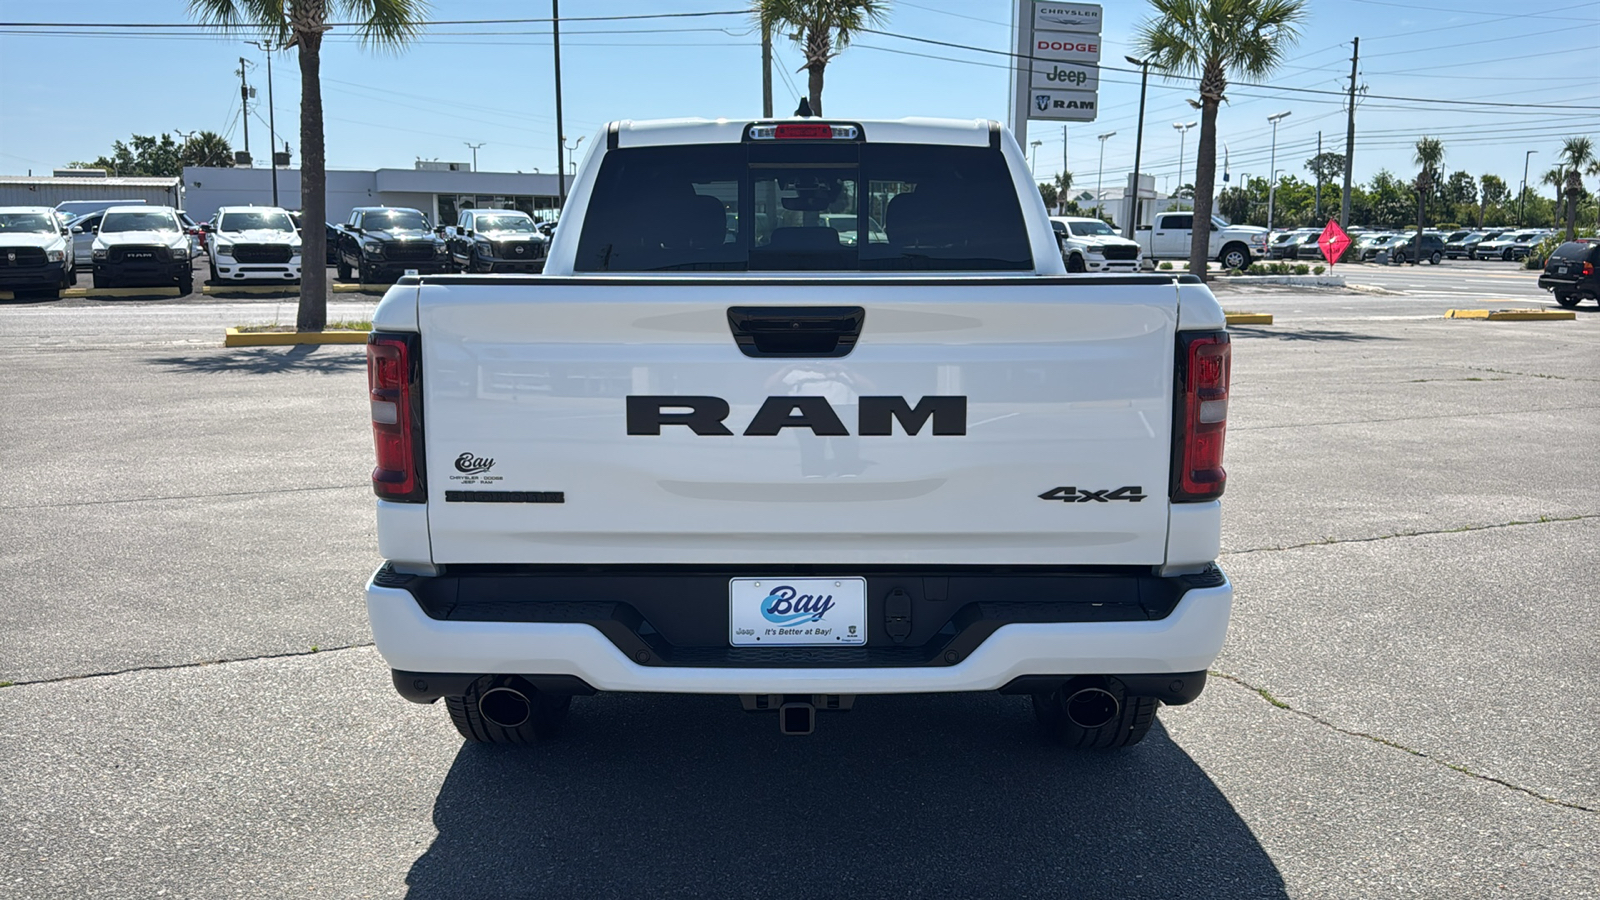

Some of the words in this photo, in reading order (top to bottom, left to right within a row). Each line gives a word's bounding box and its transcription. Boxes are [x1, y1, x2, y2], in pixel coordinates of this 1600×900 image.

[1040, 8, 1098, 17] CHRYSLER
[1037, 41, 1098, 53] DODGE
[1046, 65, 1087, 87] Jeep
[1053, 100, 1094, 110] RAM
[626, 395, 967, 436] RAM
[454, 452, 496, 475] Bay
[761, 585, 835, 623] Bay
[736, 627, 755, 636] Jeep
[764, 628, 777, 636] It's
[778, 628, 803, 636] Better
[804, 628, 813, 636] at
[814, 628, 832, 637] Bay!
